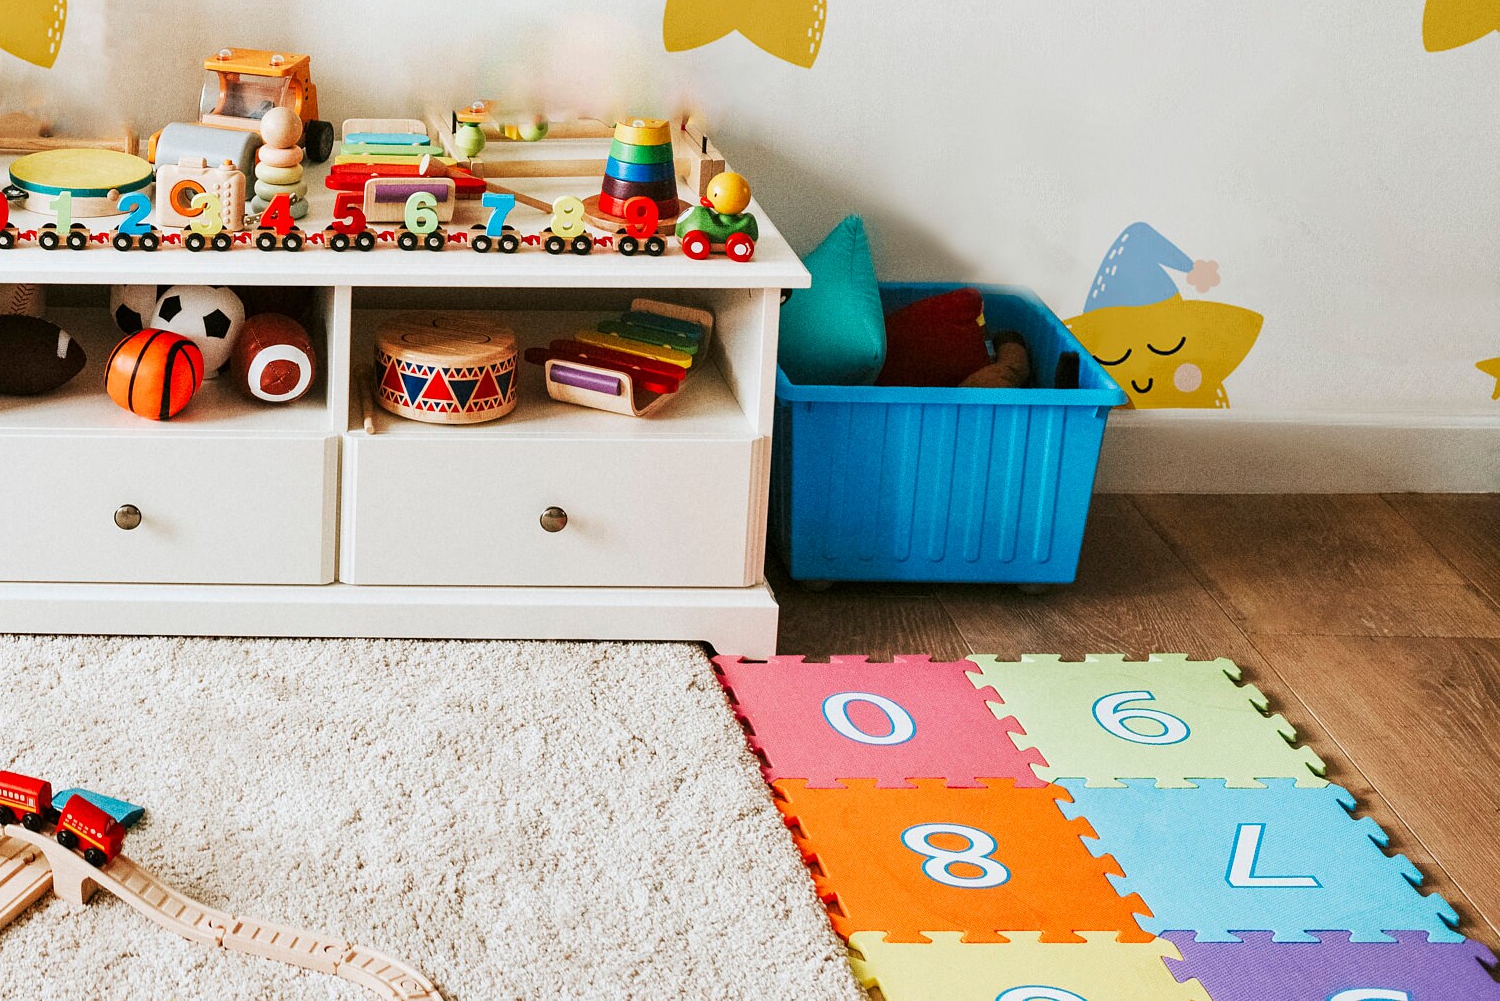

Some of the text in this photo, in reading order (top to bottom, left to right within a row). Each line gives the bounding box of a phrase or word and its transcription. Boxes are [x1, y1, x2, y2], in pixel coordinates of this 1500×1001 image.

[49, 191, 73, 234] 1
[118, 192, 153, 235] 2
[190, 193, 222, 235] 3
[260, 193, 295, 235] 4
[332, 193, 367, 234] 5
[405, 191, 439, 234] 6
[482, 193, 516, 236] 7
[551, 196, 586, 238] 8
[624, 196, 659, 238] 9
[821, 691, 917, 746] 0
[900, 822, 1012, 889] 8
